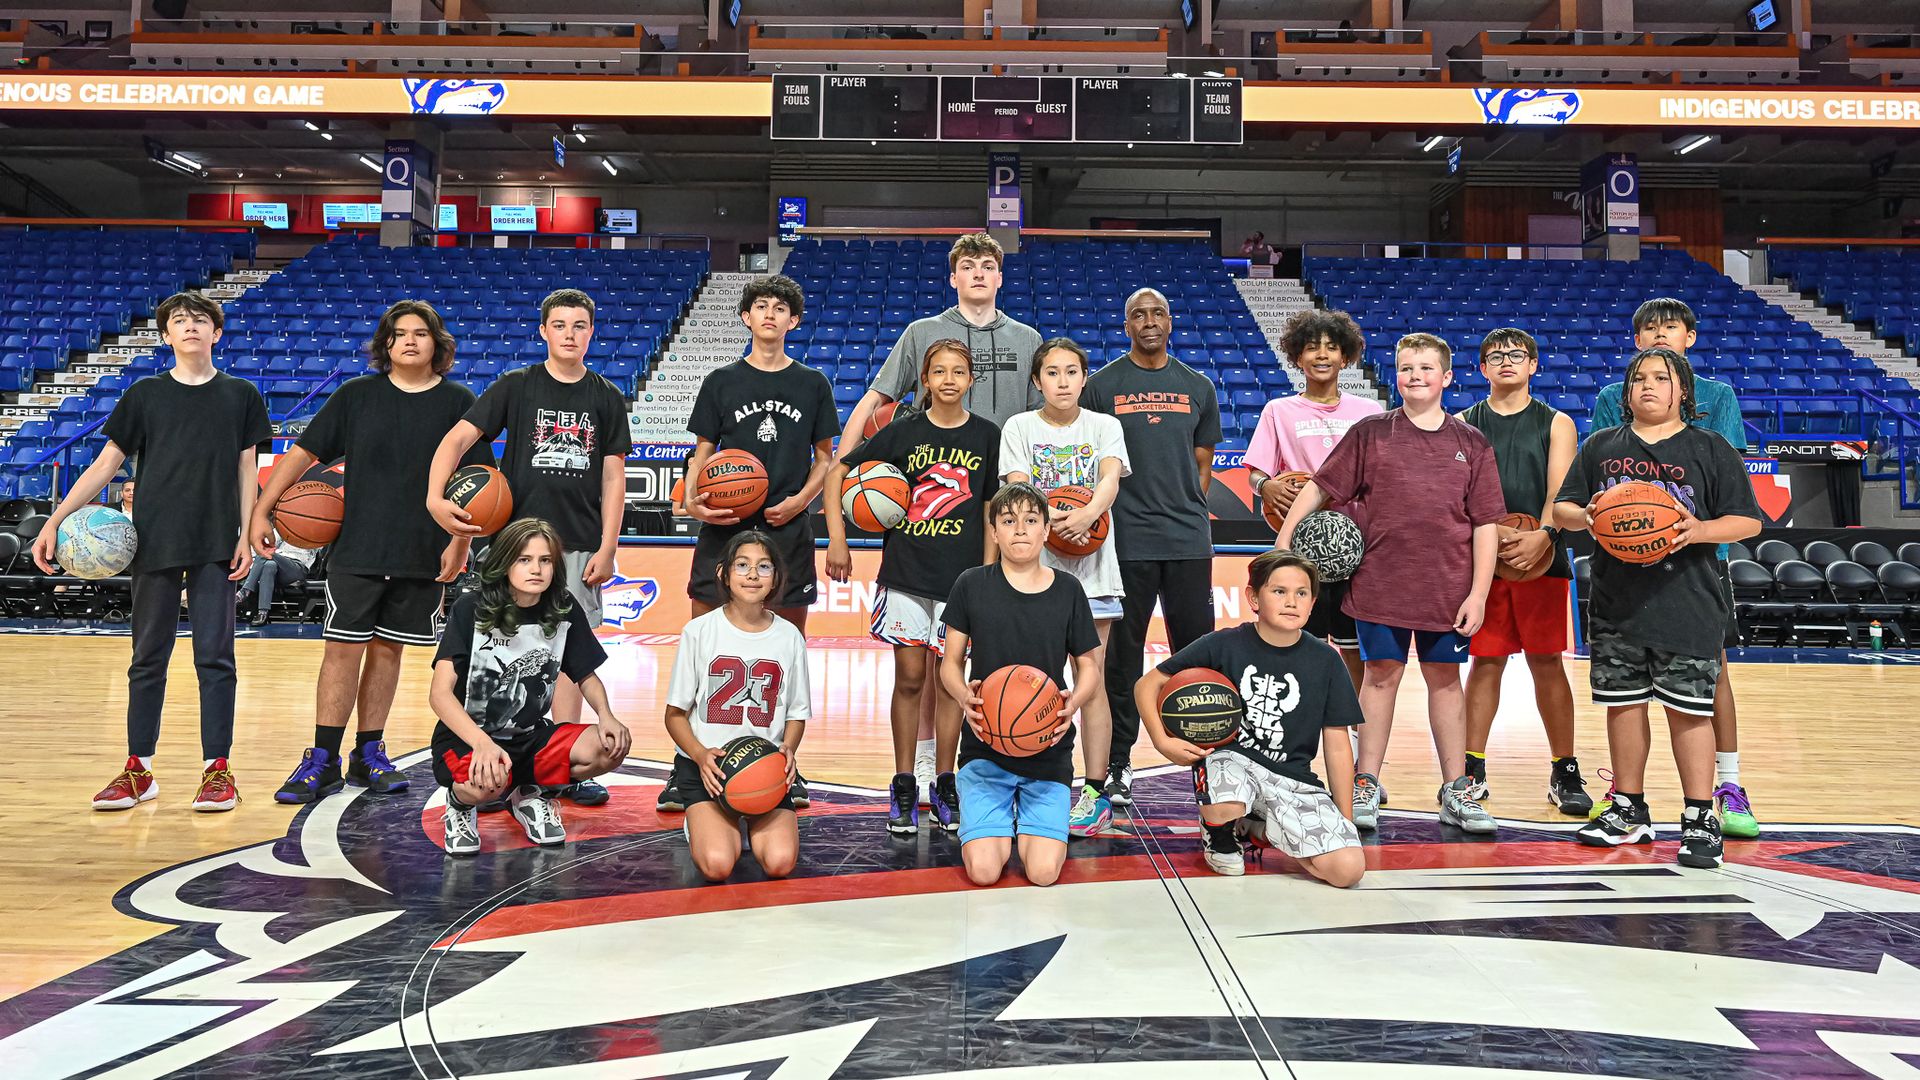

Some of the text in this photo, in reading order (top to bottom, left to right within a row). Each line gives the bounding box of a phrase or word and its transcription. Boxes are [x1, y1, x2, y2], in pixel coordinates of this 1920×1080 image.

[831, 78, 866, 87] PLAYER
[1083, 80, 1118, 90] PLAYER
[79, 83, 245, 104] CELEBRATION
[253, 85, 324, 105] GAME
[785, 85, 809, 95] TEAM
[783, 96, 810, 106] FOULS
[1205, 94, 1229, 104] TEAM
[948, 103, 976, 113] HOME
[994, 108, 1018, 116] PERIOD
[1035, 103, 1067, 114] GUEST
[1204, 104, 1231, 115] FOULS
[1660, 98, 1815, 119] INDIGENOUS
[993, 154, 1017, 162] Section
[386, 157, 410, 187] Q
[995, 166, 1015, 195] P
[1610, 170, 1635, 197] O
[971, 353, 1018, 363] NDITS
[671, 374, 701, 382] ODLUM
[1338, 382, 1365, 390] ROWN
[658, 394, 690, 402] ODLUM
[1114, 392, 1190, 406] BANDITS
[734, 399, 803, 423] ALL STAR
[537, 408, 594, 432] にほん
[646, 416, 679, 425] ODLUM
[645, 445, 691, 458] Centre
[915, 443, 931, 455] THE
[906, 447, 982, 474] ROLLING
[706, 462, 755, 479] Wilson
[1600, 457, 1685, 480] TORONTO
[1612, 517, 1655, 533] NCAA
[1608, 536, 1668, 555] Wilson
[706, 654, 785, 728] 23
[1176, 693, 1235, 712] SPALDING
[1180, 717, 1232, 732] LEGACY
